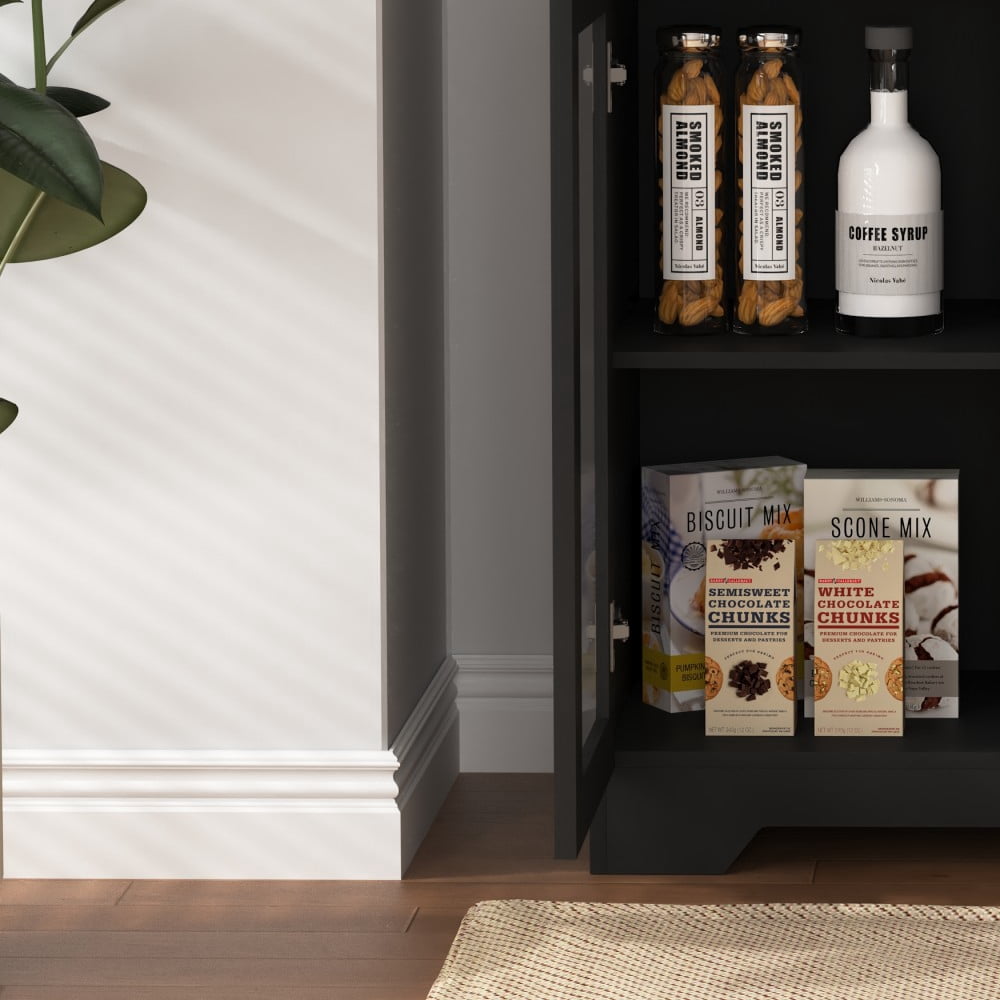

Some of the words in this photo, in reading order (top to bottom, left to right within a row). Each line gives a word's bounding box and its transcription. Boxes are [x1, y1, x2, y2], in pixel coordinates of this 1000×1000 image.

[676, 120, 688, 180] ALMOND
[690, 121, 702, 181] SMOKED
[756, 120, 768, 180] ALMOND
[770, 121, 782, 181] SMOKED
[696, 216, 704, 251] ALMOND
[848, 226, 888, 241] COFFEE
[892, 226, 928, 241] SYRUP
[687, 507, 754, 532] BISCUIT
[763, 504, 791, 526] MIX
[831, 516, 890, 538] SCONE
[900, 517, 931, 538] MIX
[650, 560, 661, 634] BISCUIT
[708, 588, 790, 596] SEMISWEET
[818, 587, 874, 597] WHITE
[708, 600, 790, 608] CHOCOLATE
[818, 600, 900, 608] CHOCOLATE
[708, 612, 790, 624] CHUNKS
[817, 612, 900, 624] CHUNKS
